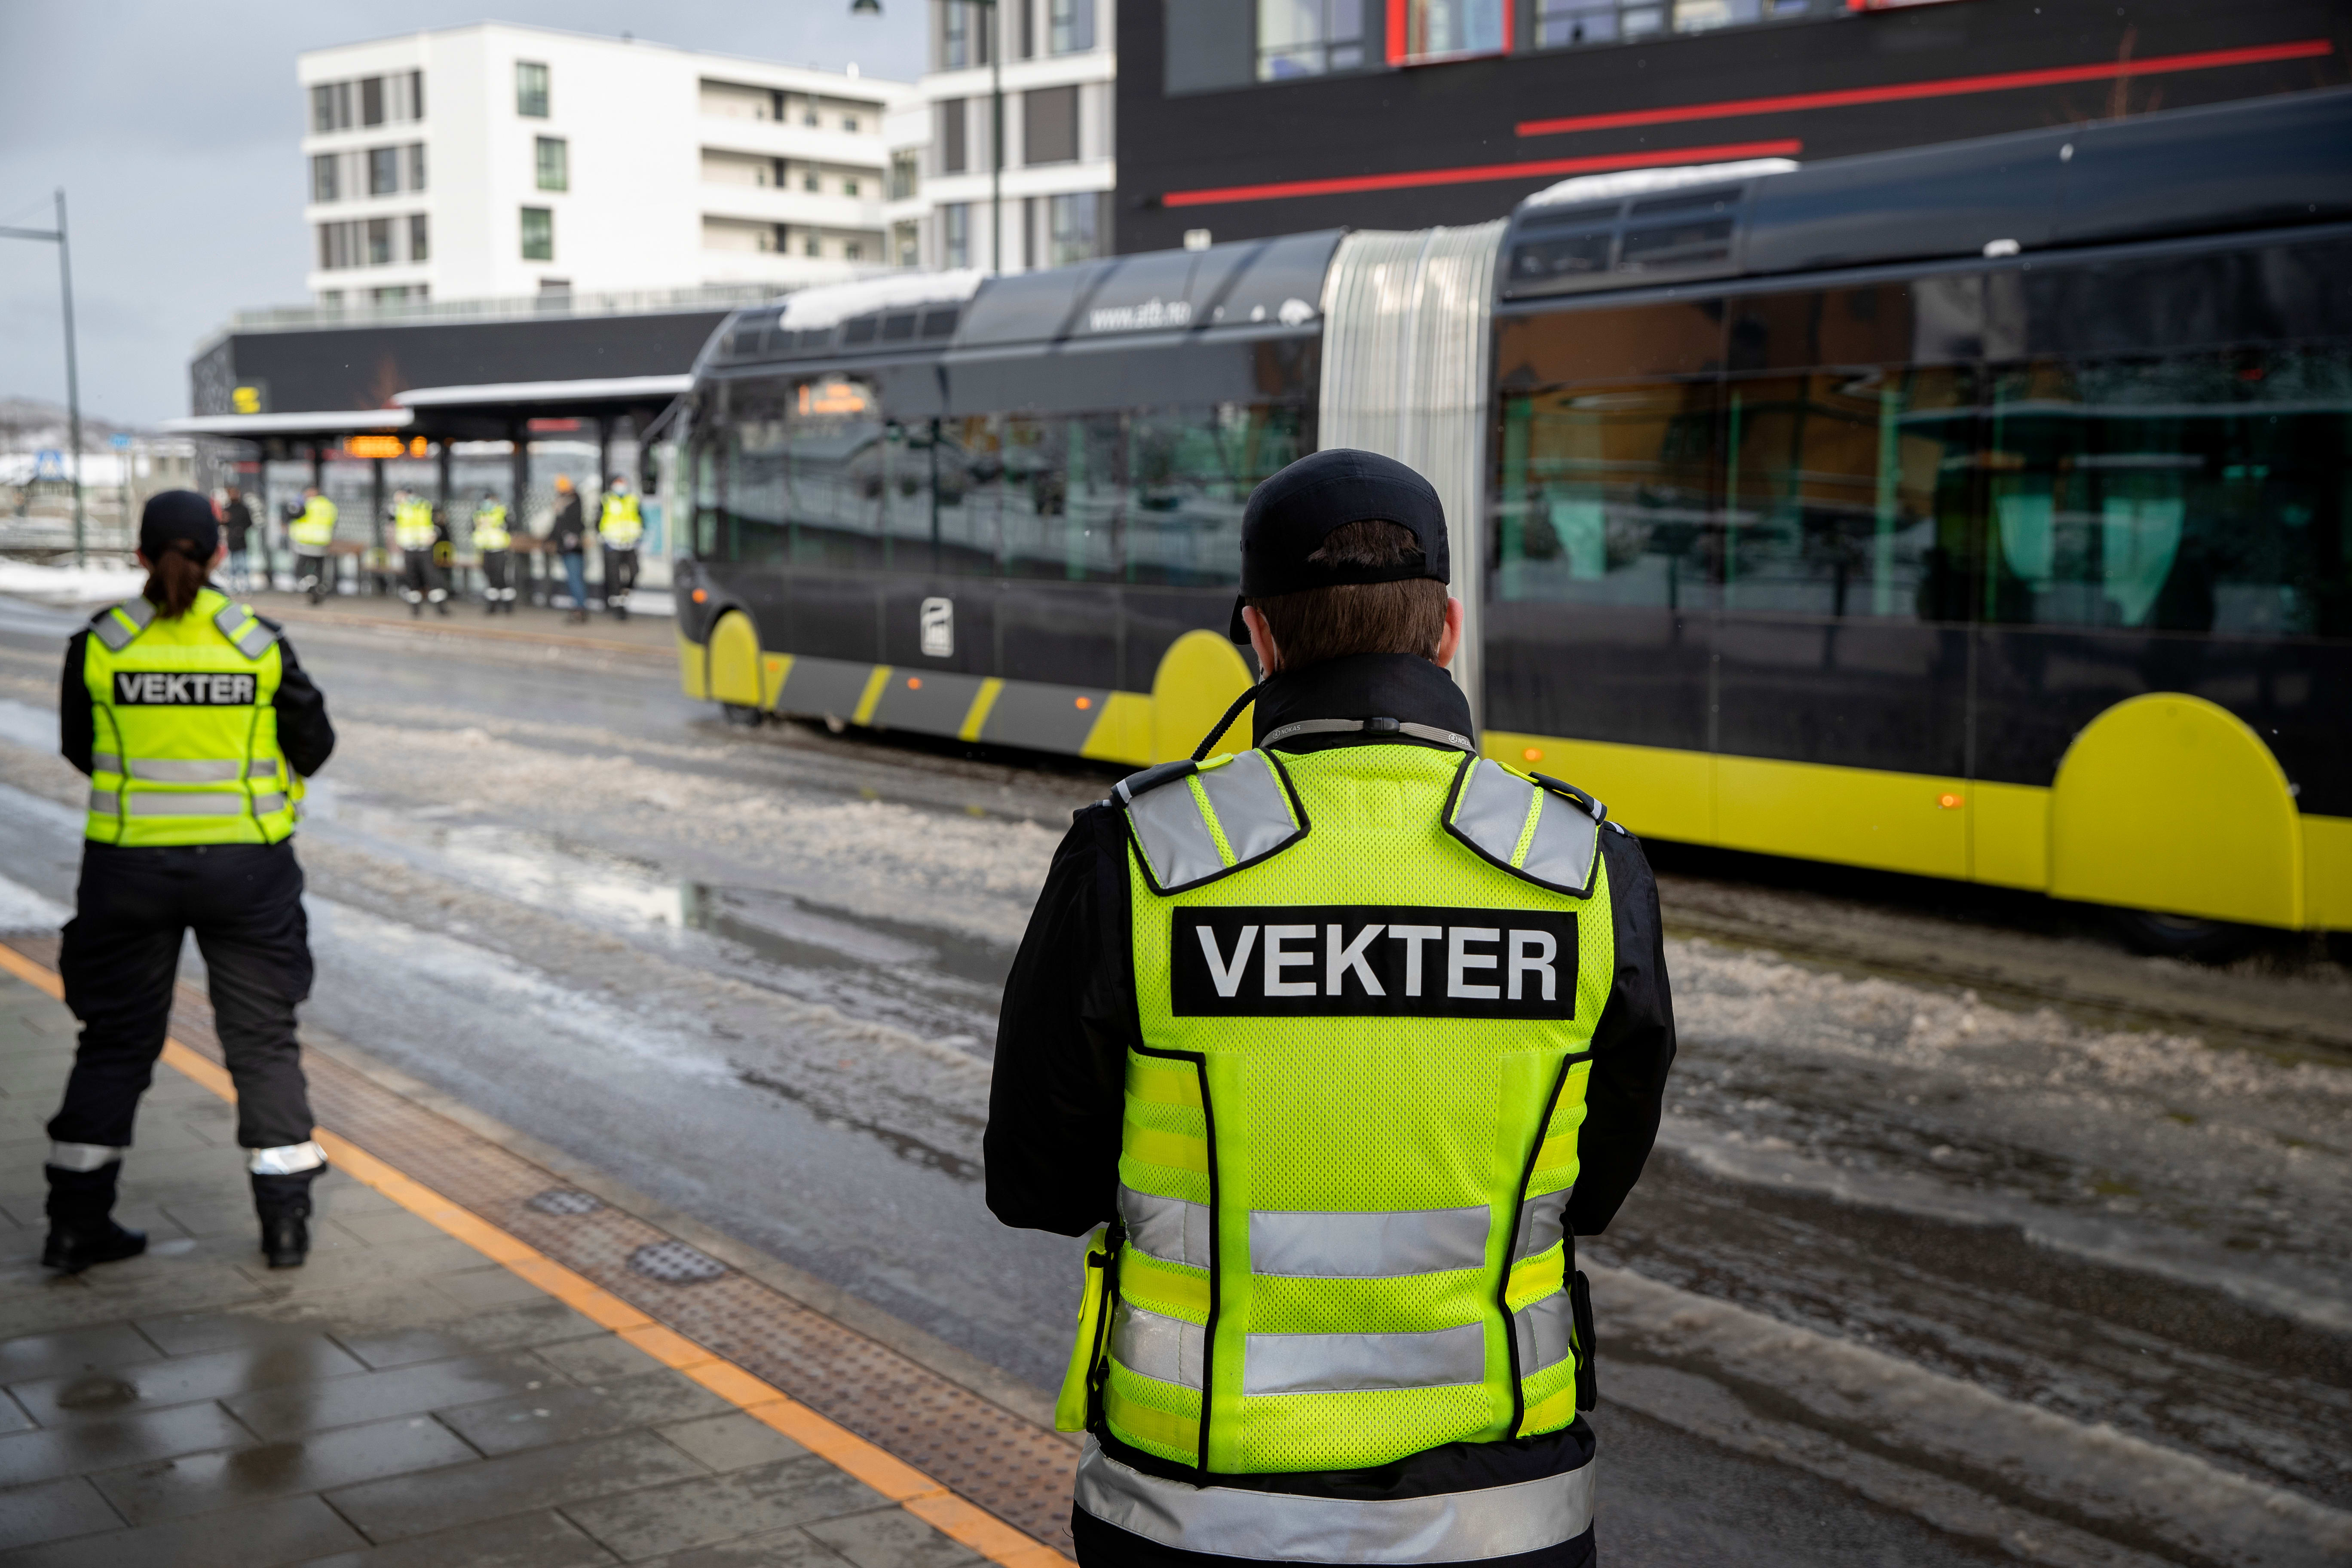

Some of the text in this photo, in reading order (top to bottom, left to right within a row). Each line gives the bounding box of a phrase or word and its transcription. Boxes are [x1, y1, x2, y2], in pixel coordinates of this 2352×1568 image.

[117, 673, 254, 704] VEKTER
[1281, 725, 1301, 735] NOKAS
[1195, 924, 1557, 1001] VEKTER
